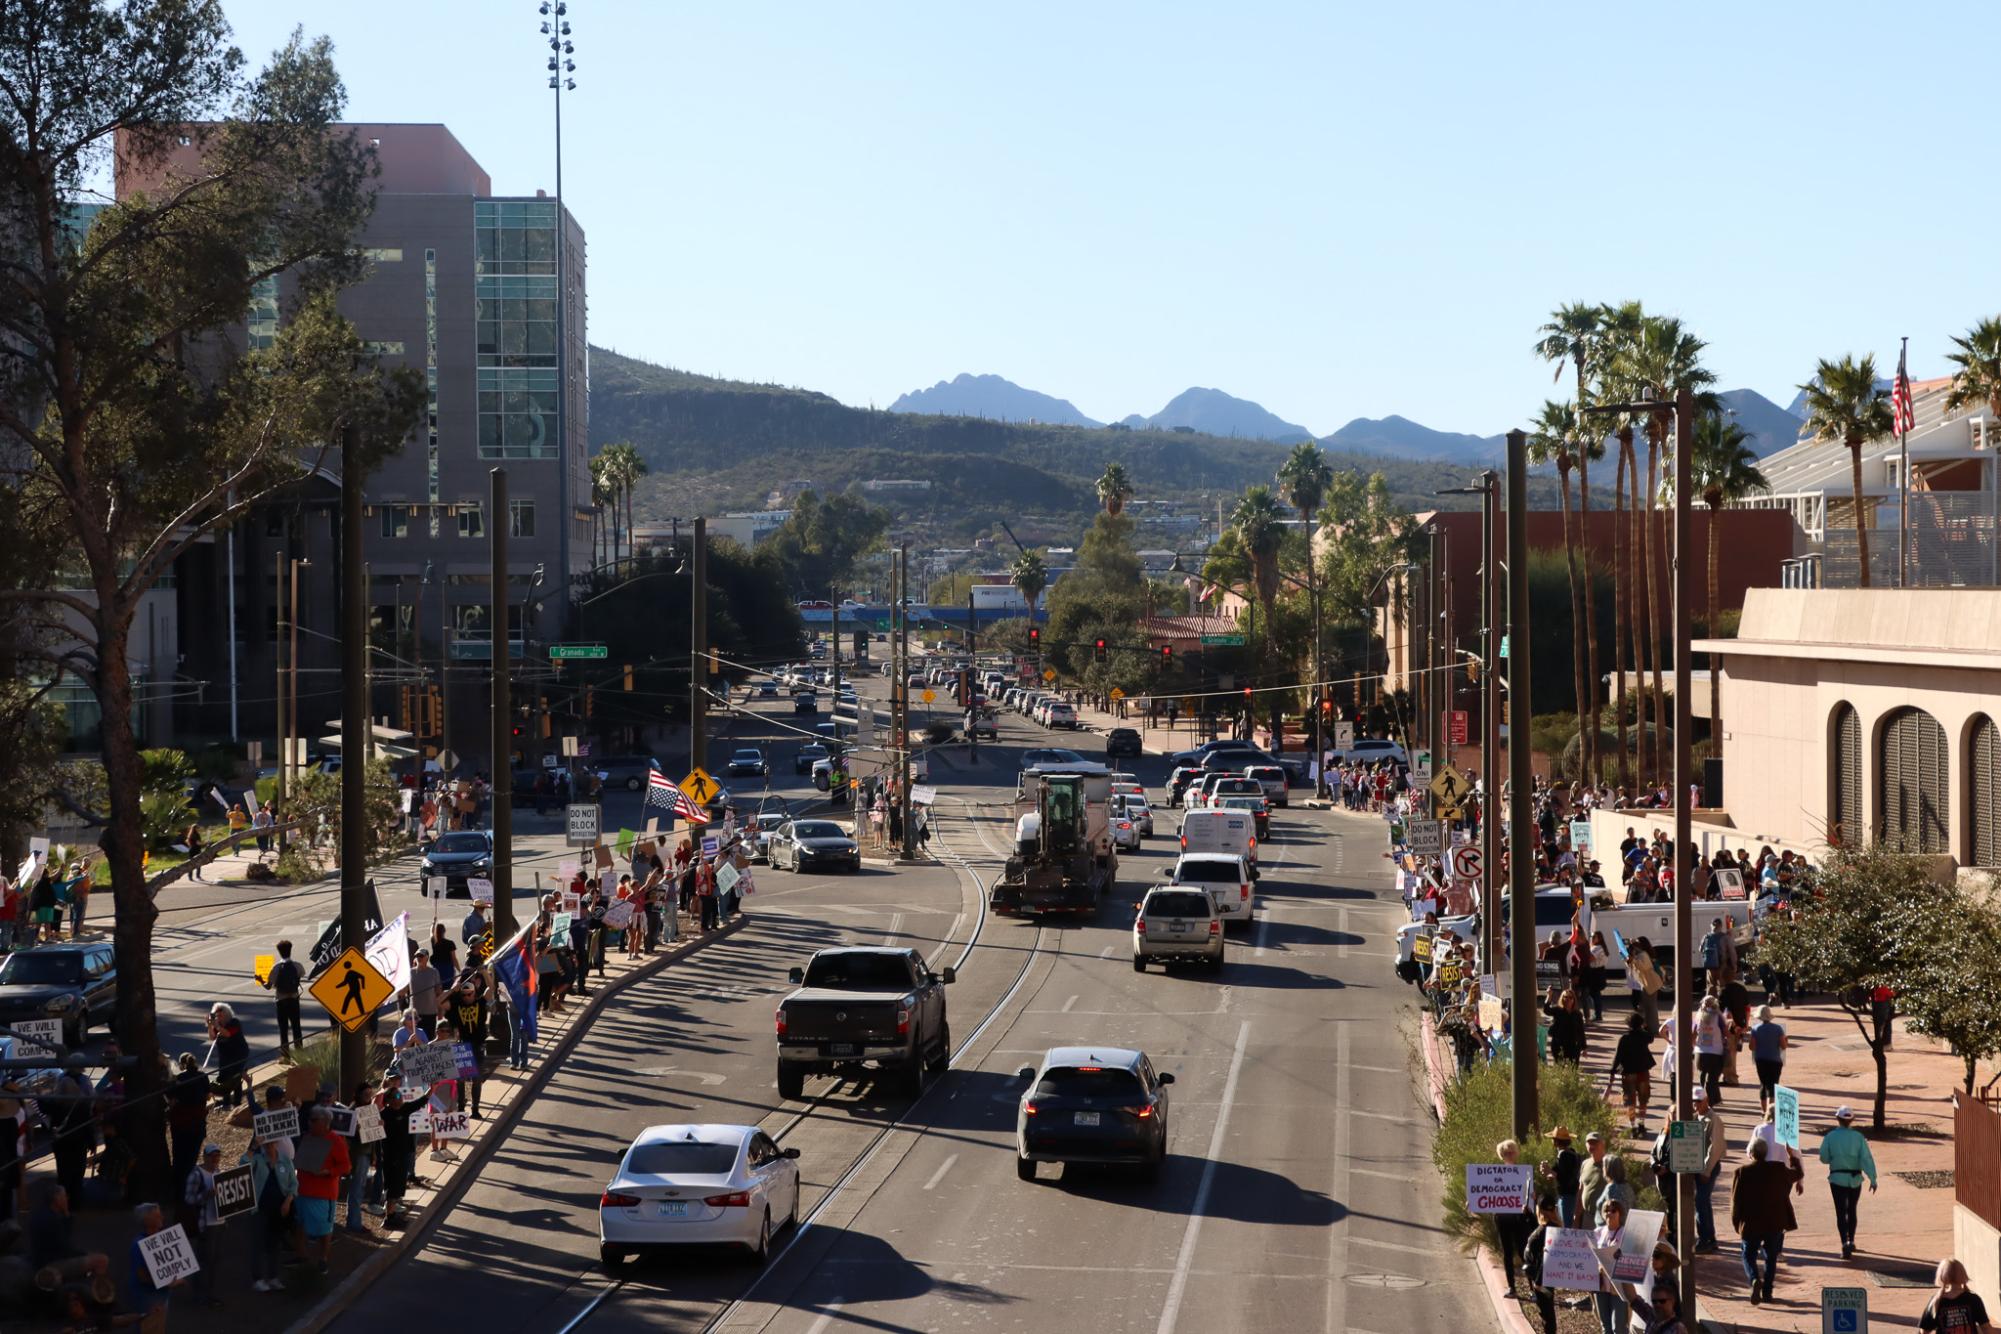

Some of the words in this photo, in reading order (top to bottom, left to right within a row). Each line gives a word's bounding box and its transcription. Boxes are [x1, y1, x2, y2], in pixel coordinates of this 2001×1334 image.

[571, 809, 580, 818] DO
[581, 809, 595, 818] NOT
[571, 820, 596, 830] BLOCK
[1412, 825, 1422, 834] DO
[1423, 824, 1437, 832] NOT
[1414, 836, 1438, 845] BLOCK
[17, 1023, 32, 1033] WE
[34, 1020, 57, 1032] WILL
[256, 1116, 267, 1127] NO
[267, 1110, 296, 1124] TRUMP!
[434, 1115, 468, 1133] WAR
[257, 1124, 271, 1136] NO
[273, 1119, 297, 1132] KKK!
[1674, 1125, 1681, 1136] 2
[1476, 1166, 1520, 1176] DICTATOR
[216, 1174, 251, 1207] RESIST
[1470, 1183, 1523, 1194] DEMOCRACY
[1477, 1195, 1523, 1209] CHOOSE
[143, 1236, 160, 1252] WE
[159, 1229, 181, 1246] WILL
[152, 1242, 183, 1267] NOT
[155, 1257, 192, 1281] COMPLY
[1575, 1262, 1585, 1271] WE
[1827, 1300, 1862, 1309] PARKING
